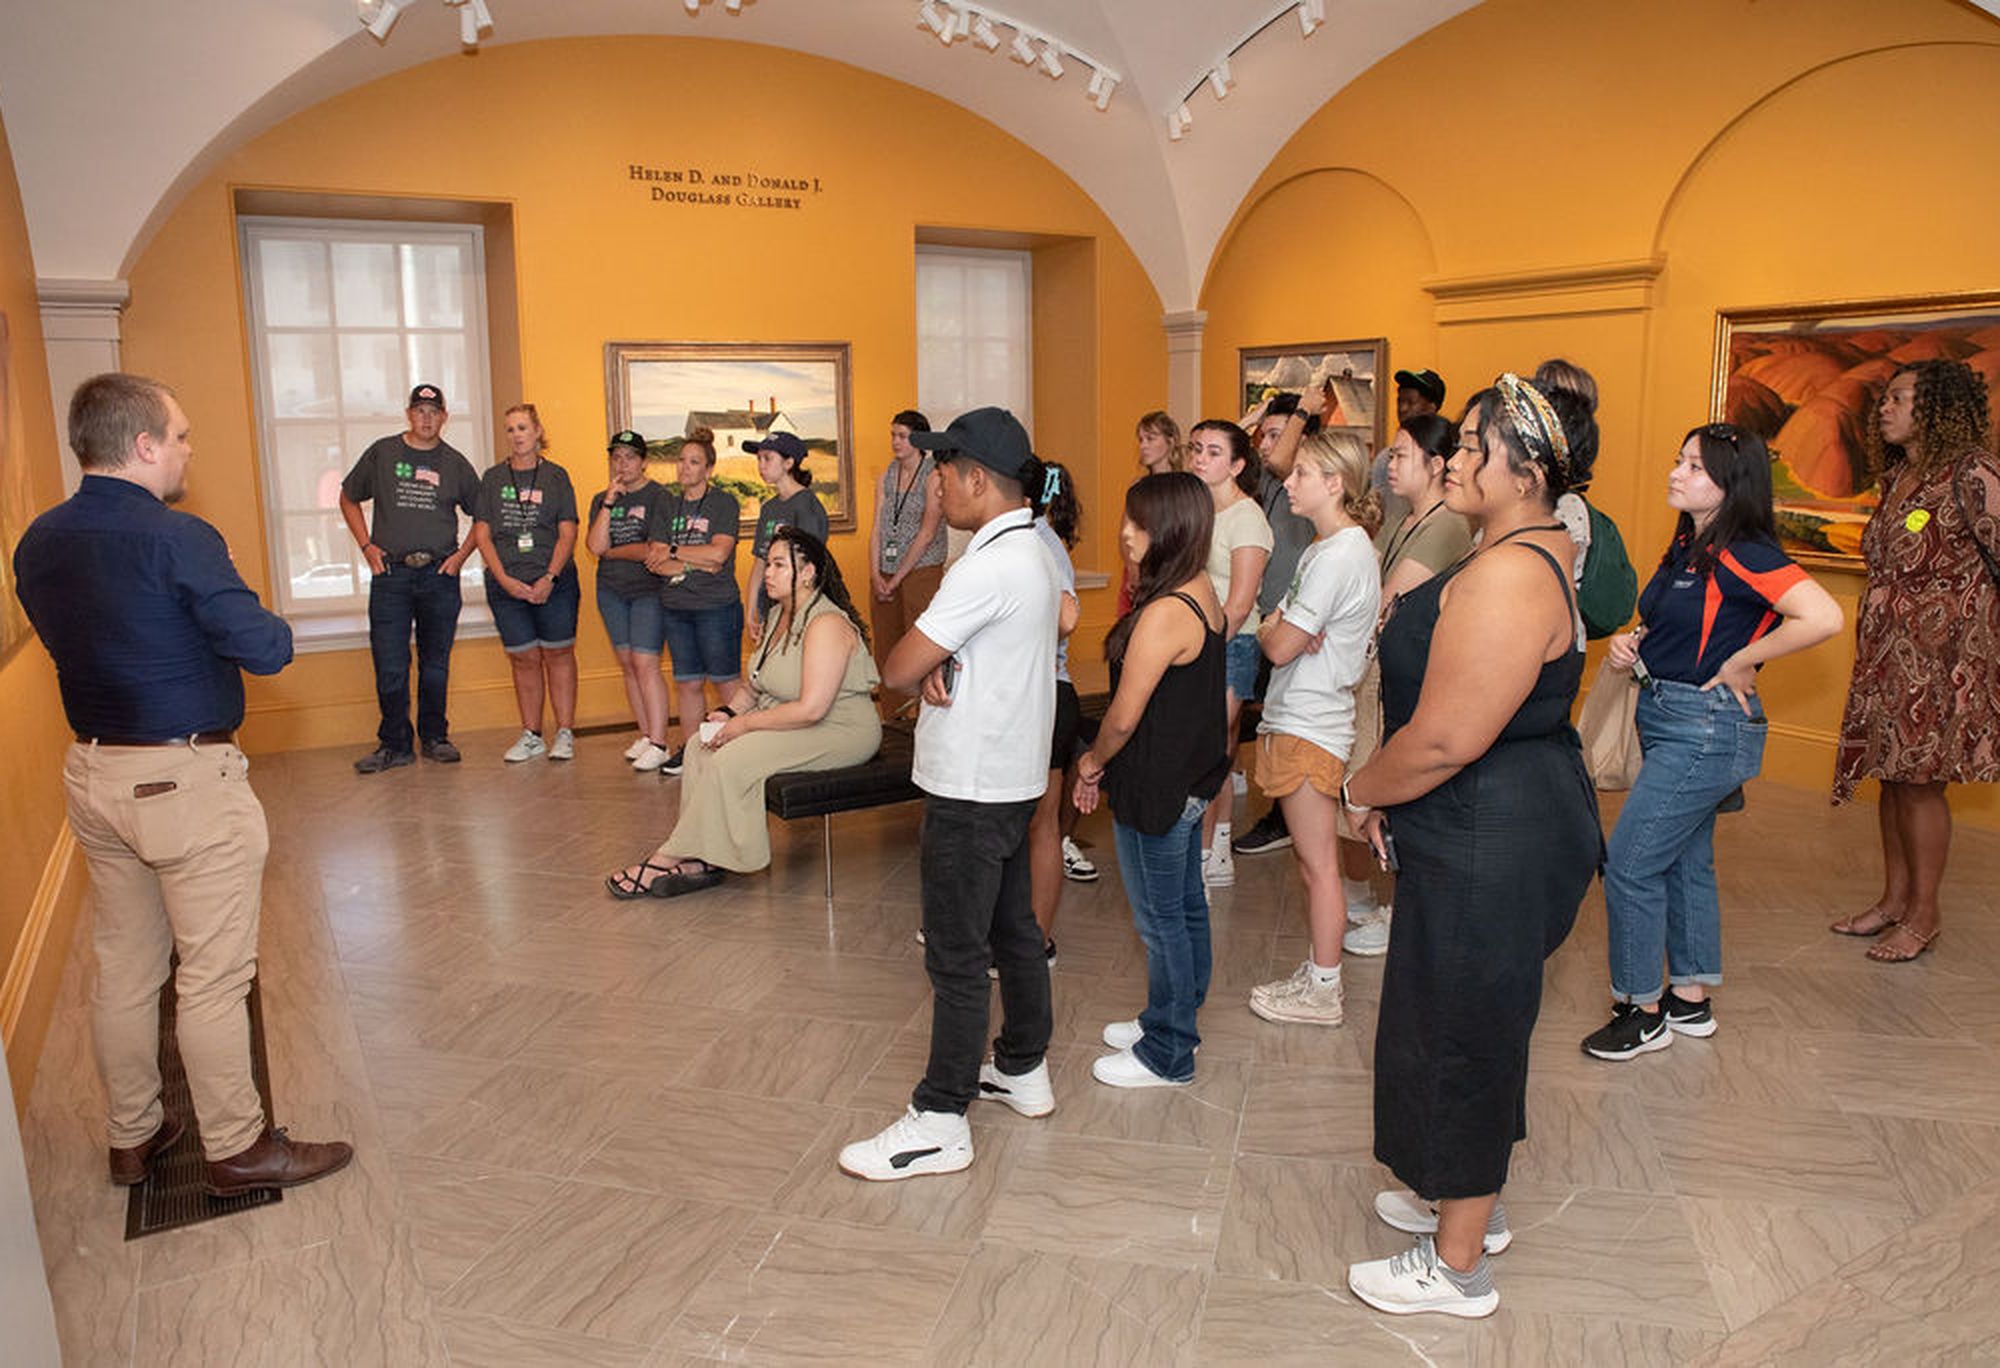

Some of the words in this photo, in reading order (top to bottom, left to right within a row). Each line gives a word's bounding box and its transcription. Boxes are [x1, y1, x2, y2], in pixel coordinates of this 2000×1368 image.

[629, 165, 683, 182] HELEN
[689, 169, 705, 184] D.
[711, 174, 741, 186] AND
[747, 173, 809, 191] DONALD
[813, 177, 823, 192] J.
[651, 187, 731, 205] DOUGLASS
[735, 193, 801, 209] GALLERY
